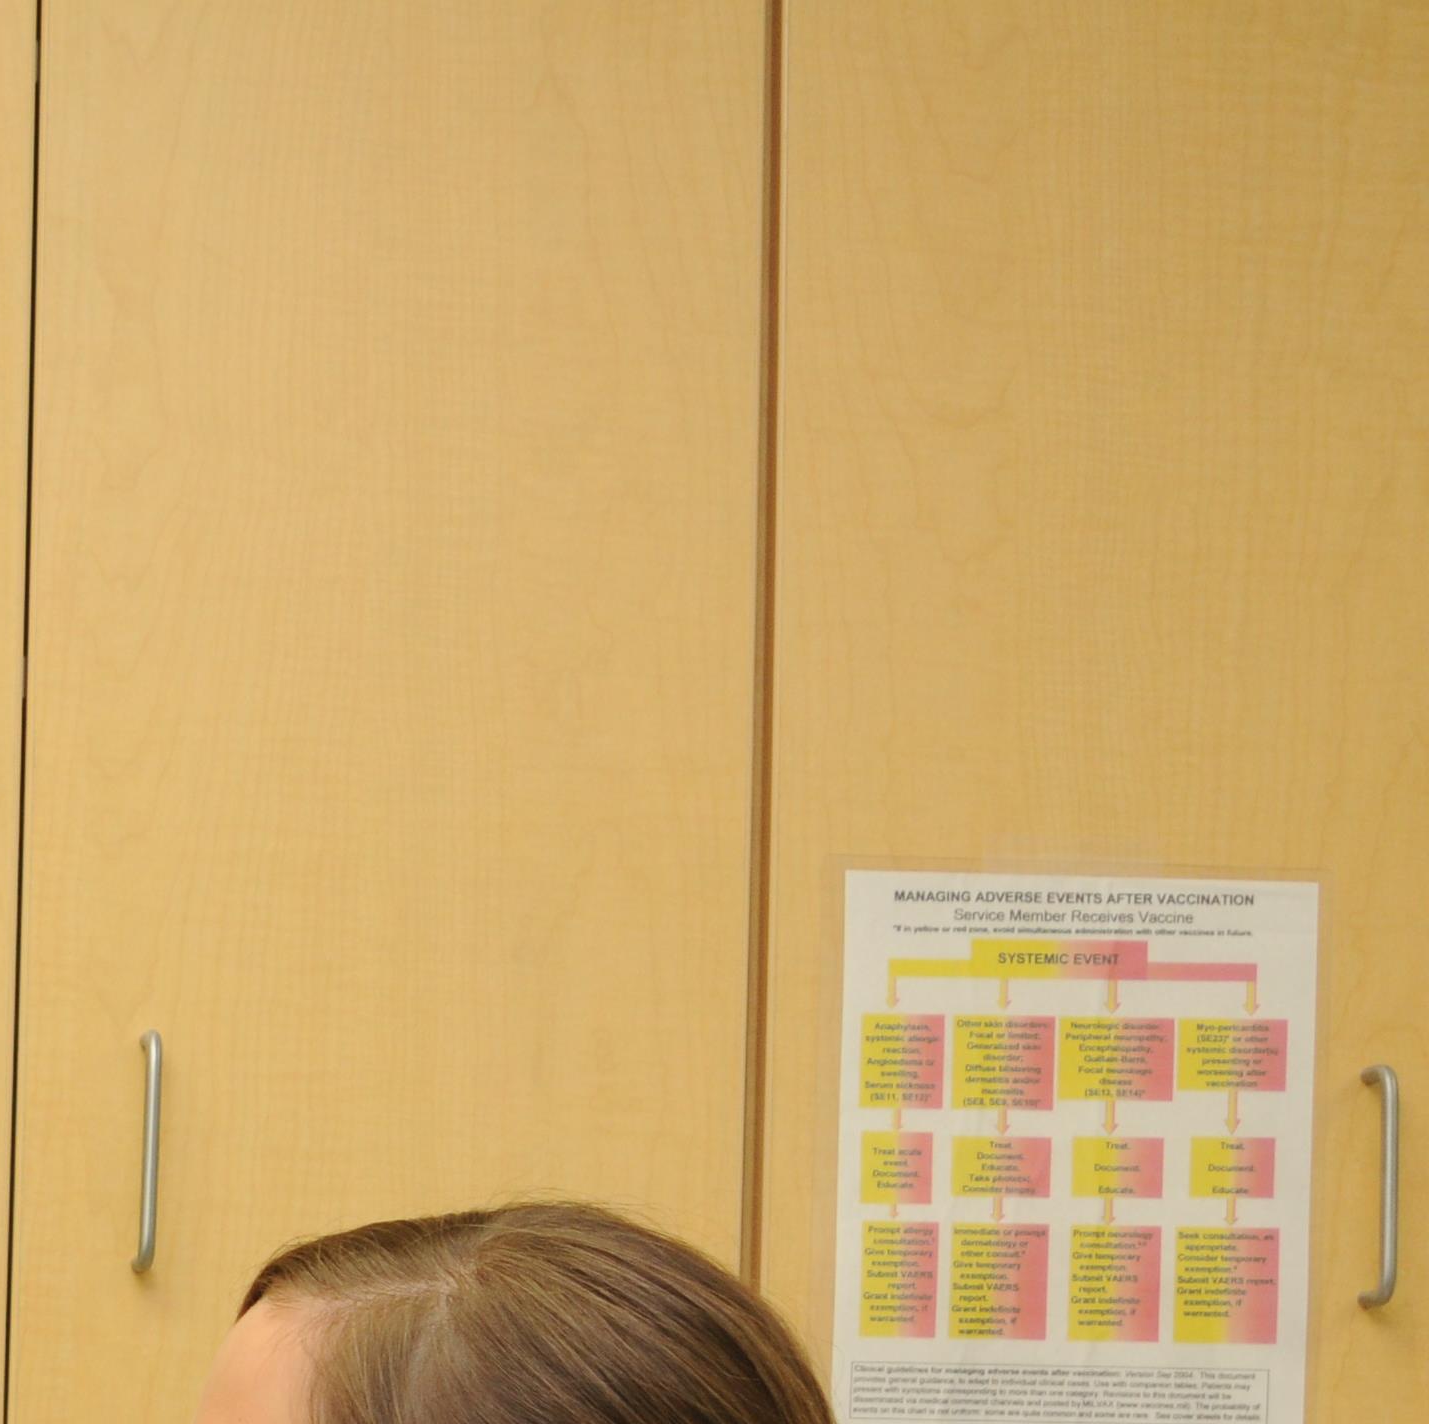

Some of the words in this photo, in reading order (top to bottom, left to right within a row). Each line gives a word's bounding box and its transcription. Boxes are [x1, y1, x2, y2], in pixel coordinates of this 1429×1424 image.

[894, 890, 971, 902] MANAGING
[975, 891, 1042, 903] ADVERSE
[1046, 892, 1102, 904] EVENTS
[1106, 892, 1152, 904] AFTER
[1156, 893, 1254, 905] VACCINATION
[954, 908, 1005, 921] Service
[1008, 908, 1066, 922] Member
[1070, 909, 1135, 923] Receives
[1137, 910, 1194, 923] Vaccine
[998, 953, 1068, 965] SYSTEMIC
[1072, 953, 1118, 965] EVENT
